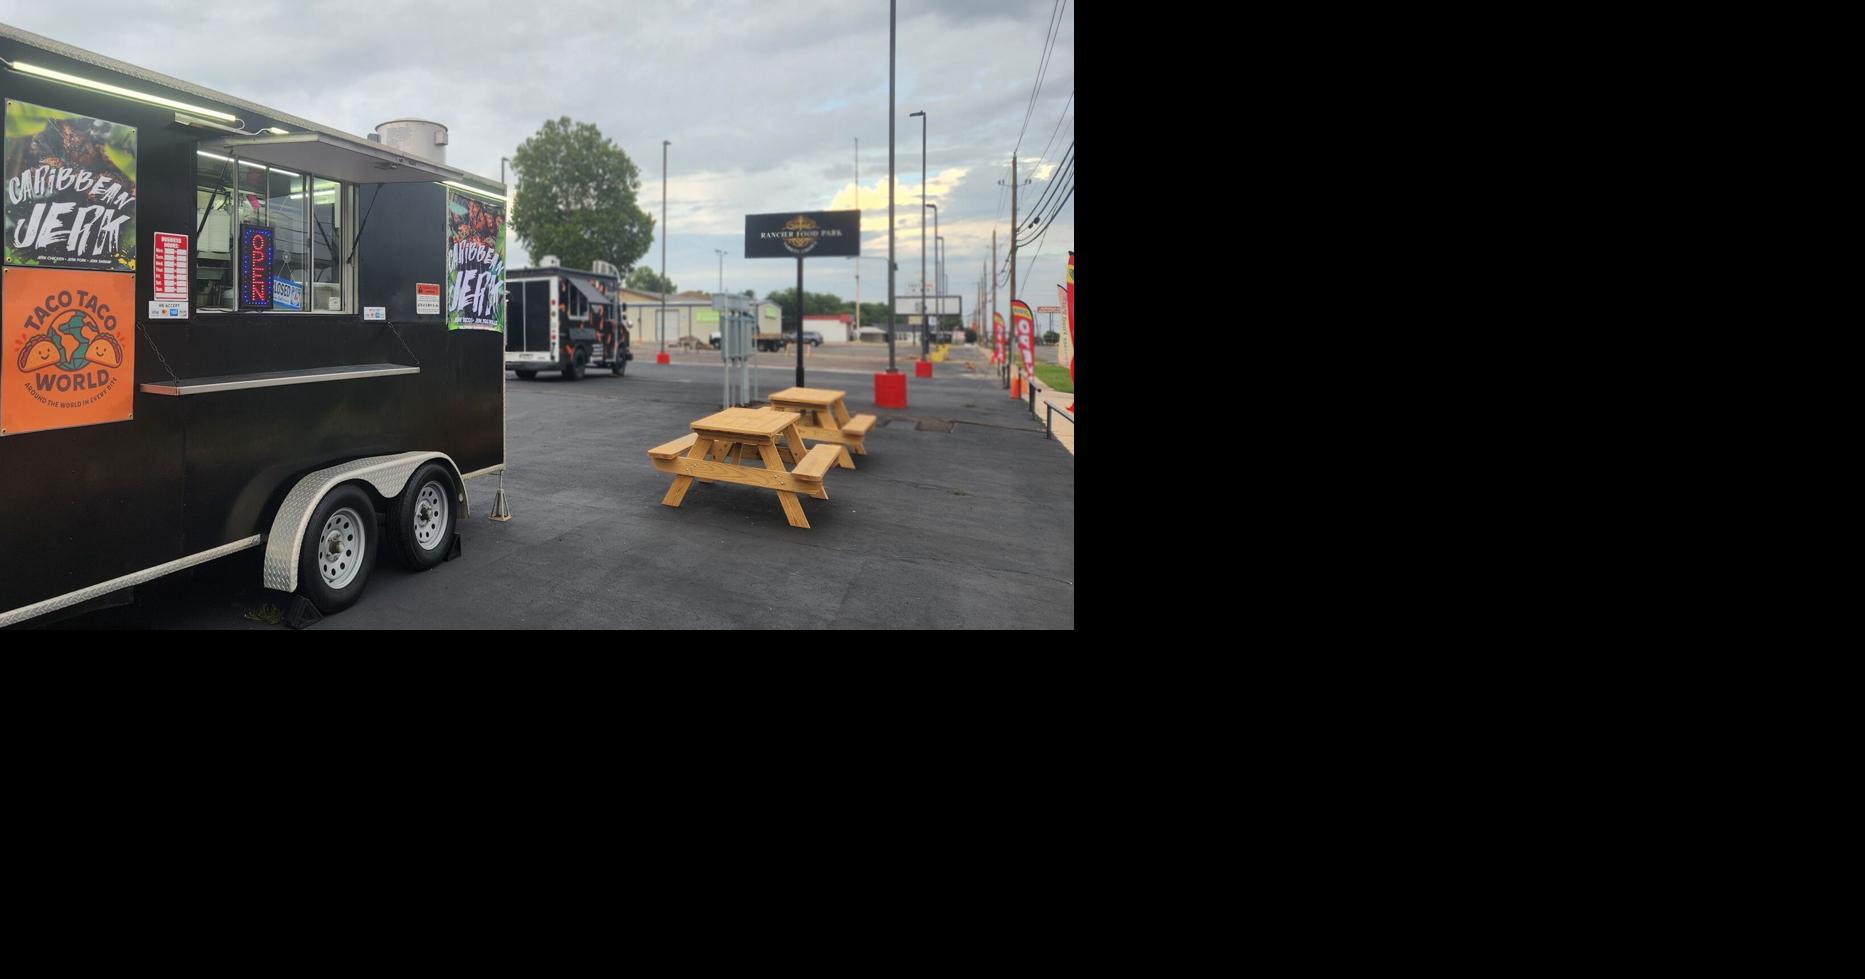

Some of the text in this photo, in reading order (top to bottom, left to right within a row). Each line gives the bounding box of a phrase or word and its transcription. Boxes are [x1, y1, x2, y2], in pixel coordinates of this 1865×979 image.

[9, 165, 135, 209] CARIBBEAN
[13, 202, 131, 256] JERK
[820, 229, 842, 237] PARK
[252, 234, 265, 301] OPEN
[448, 239, 504, 272] CARIBBEAN
[274, 281, 291, 297] LOSED
[448, 269, 504, 316] JERK
[24, 290, 117, 331] TACO TACO
[25, 382, 47, 404] AROUND
[47, 399, 58, 407] THE
[90, 390, 108, 403] EVERY
[35, 369, 110, 392] WORLD
